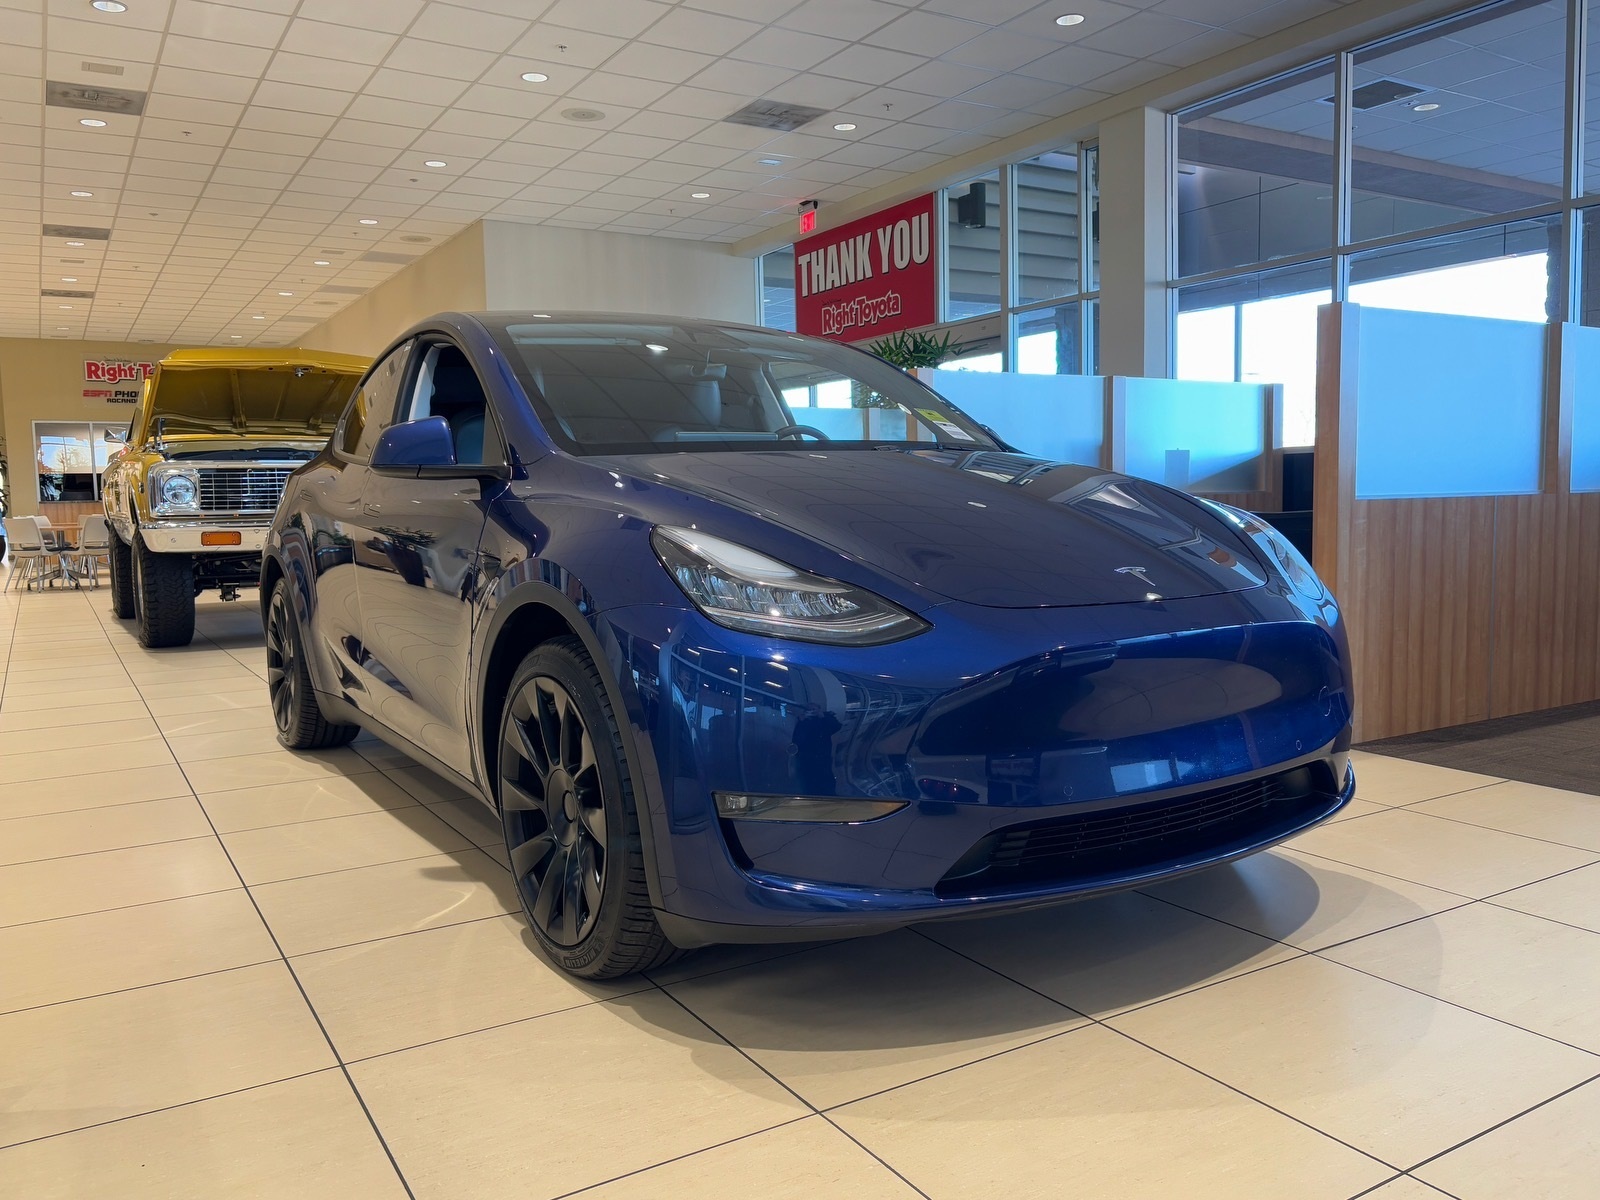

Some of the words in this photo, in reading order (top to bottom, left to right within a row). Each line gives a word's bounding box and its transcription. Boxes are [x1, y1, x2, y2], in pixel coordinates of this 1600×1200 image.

[798, 232, 873, 297] THANK
[877, 212, 929, 274] YOU
[822, 302, 856, 335] Right
[855, 290, 901, 327] Toyota
[85, 361, 137, 384] Right
[114, 390, 139, 398] PHO
[565, 947, 597, 967] MICHELIN
